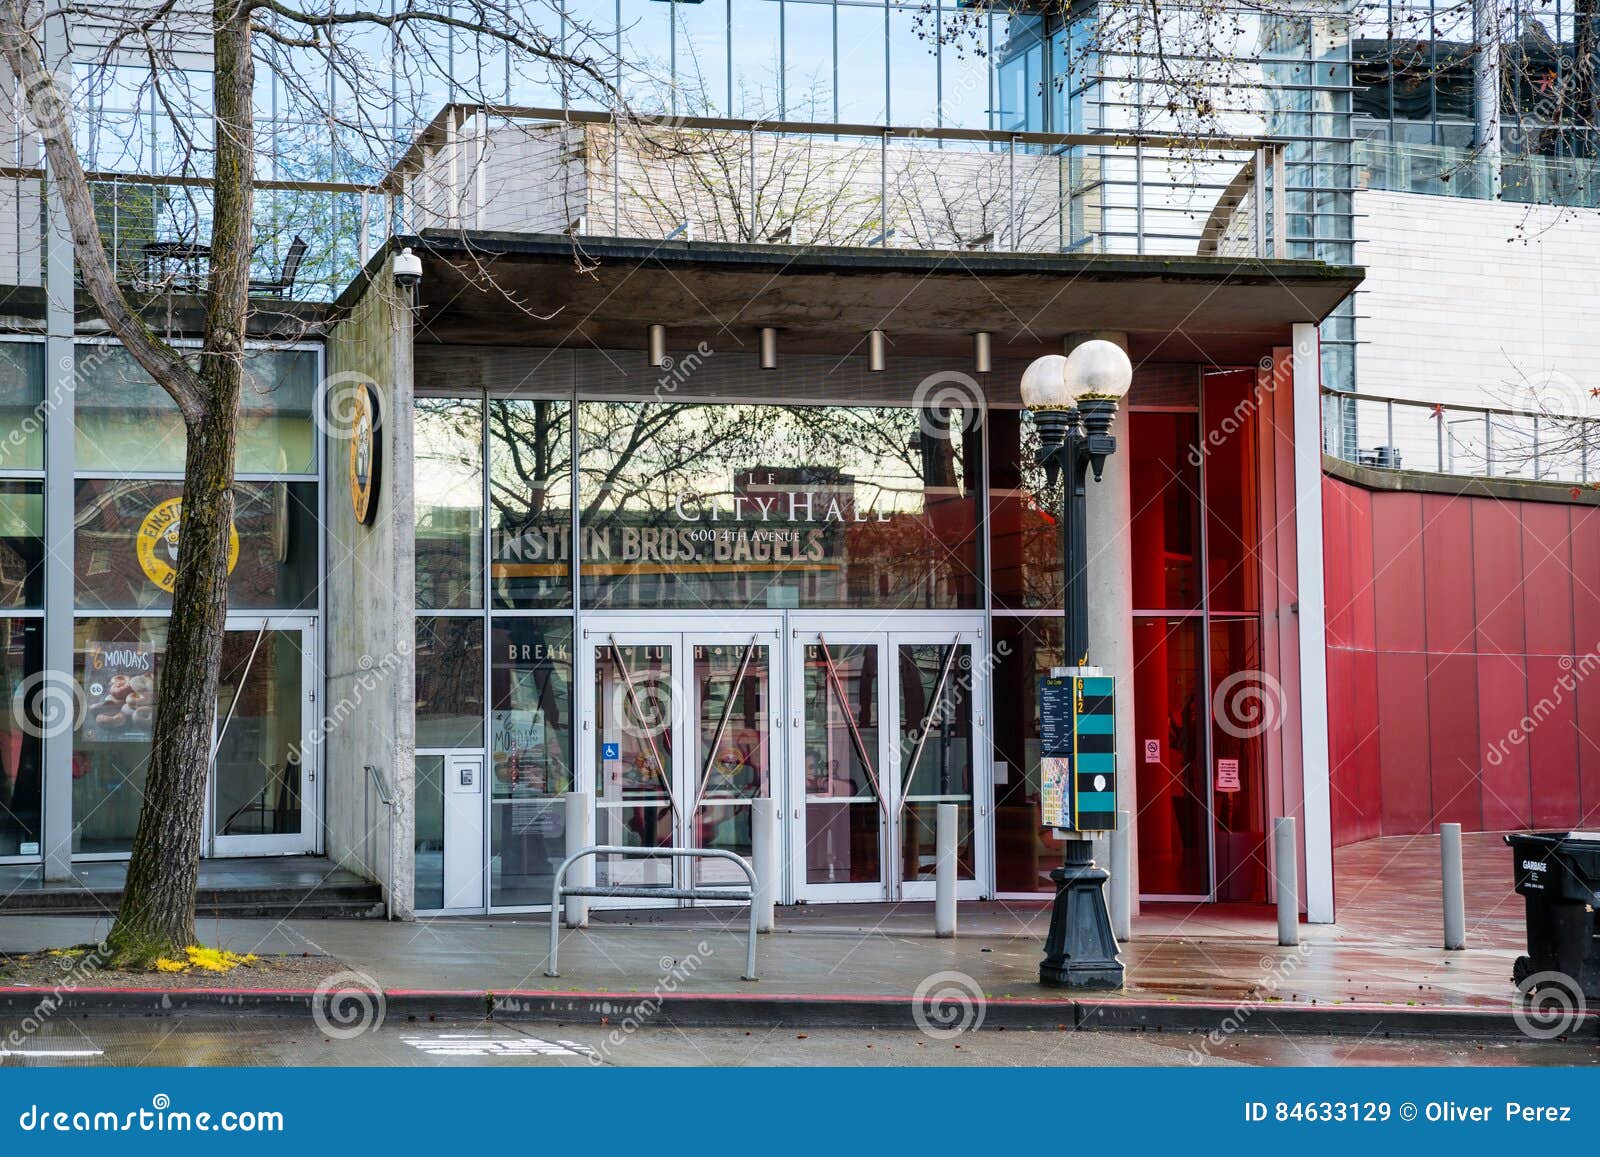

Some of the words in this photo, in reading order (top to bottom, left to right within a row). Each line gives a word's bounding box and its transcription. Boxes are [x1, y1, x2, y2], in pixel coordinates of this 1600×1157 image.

[143, 502, 181, 538] EINST
[622, 527, 703, 561] BROS.
[714, 527, 825, 561] BAGELS
[690, 529, 717, 542] 600
[104, 649, 150, 671] MONDAYS
[1522, 859, 1547, 873] GARBAGE
